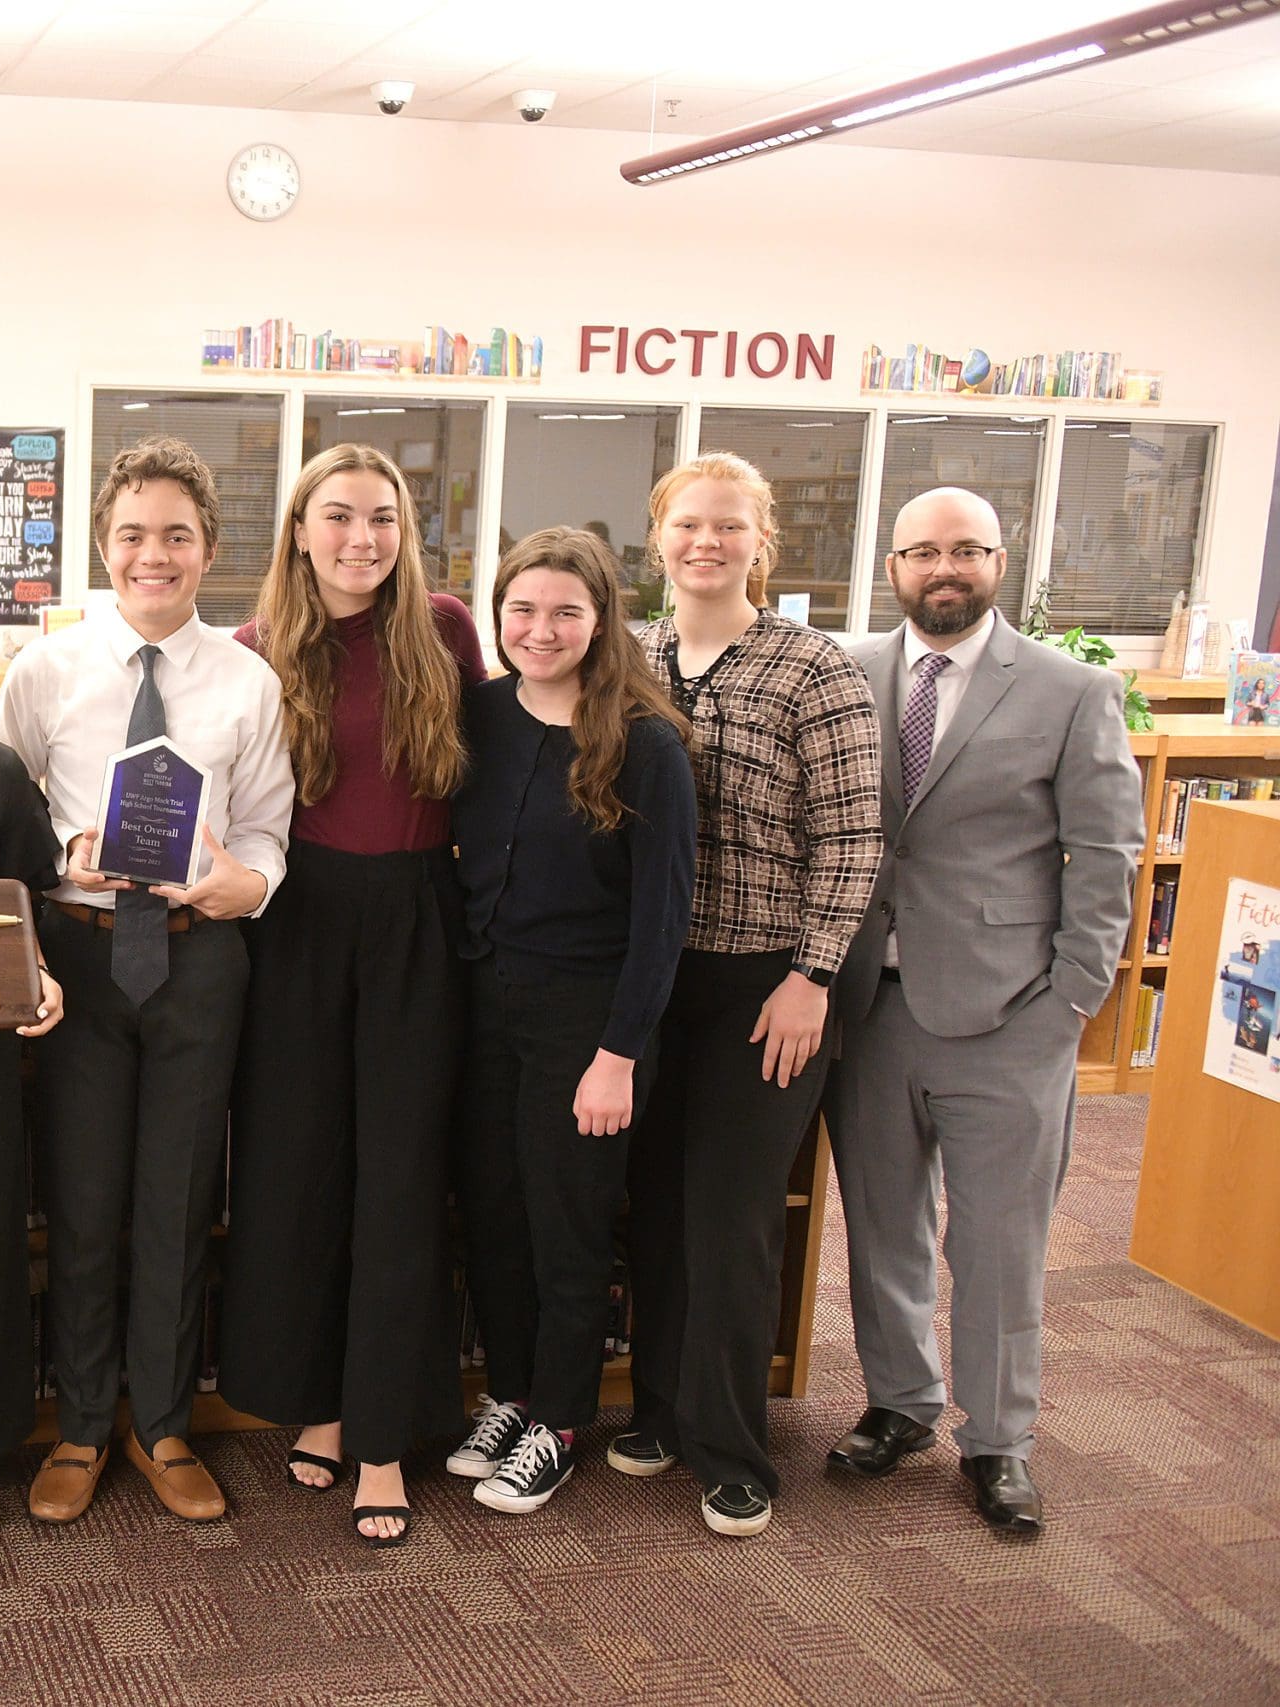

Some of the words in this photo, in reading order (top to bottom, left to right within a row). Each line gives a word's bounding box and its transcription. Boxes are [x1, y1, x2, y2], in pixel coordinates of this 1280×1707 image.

[579, 325, 835, 381] FICTION
[7, 482, 24, 495] YOU
[26, 545, 53, 565] Study
[12, 602, 26, 615] the
[120, 800, 133, 809] High
[134, 802, 153, 810] School
[153, 804, 187, 816] Tournament
[170, 799, 184, 807] Trial
[121, 820, 141, 832] Best
[144, 823, 179, 838] Overall
[135, 834, 161, 848] Team
